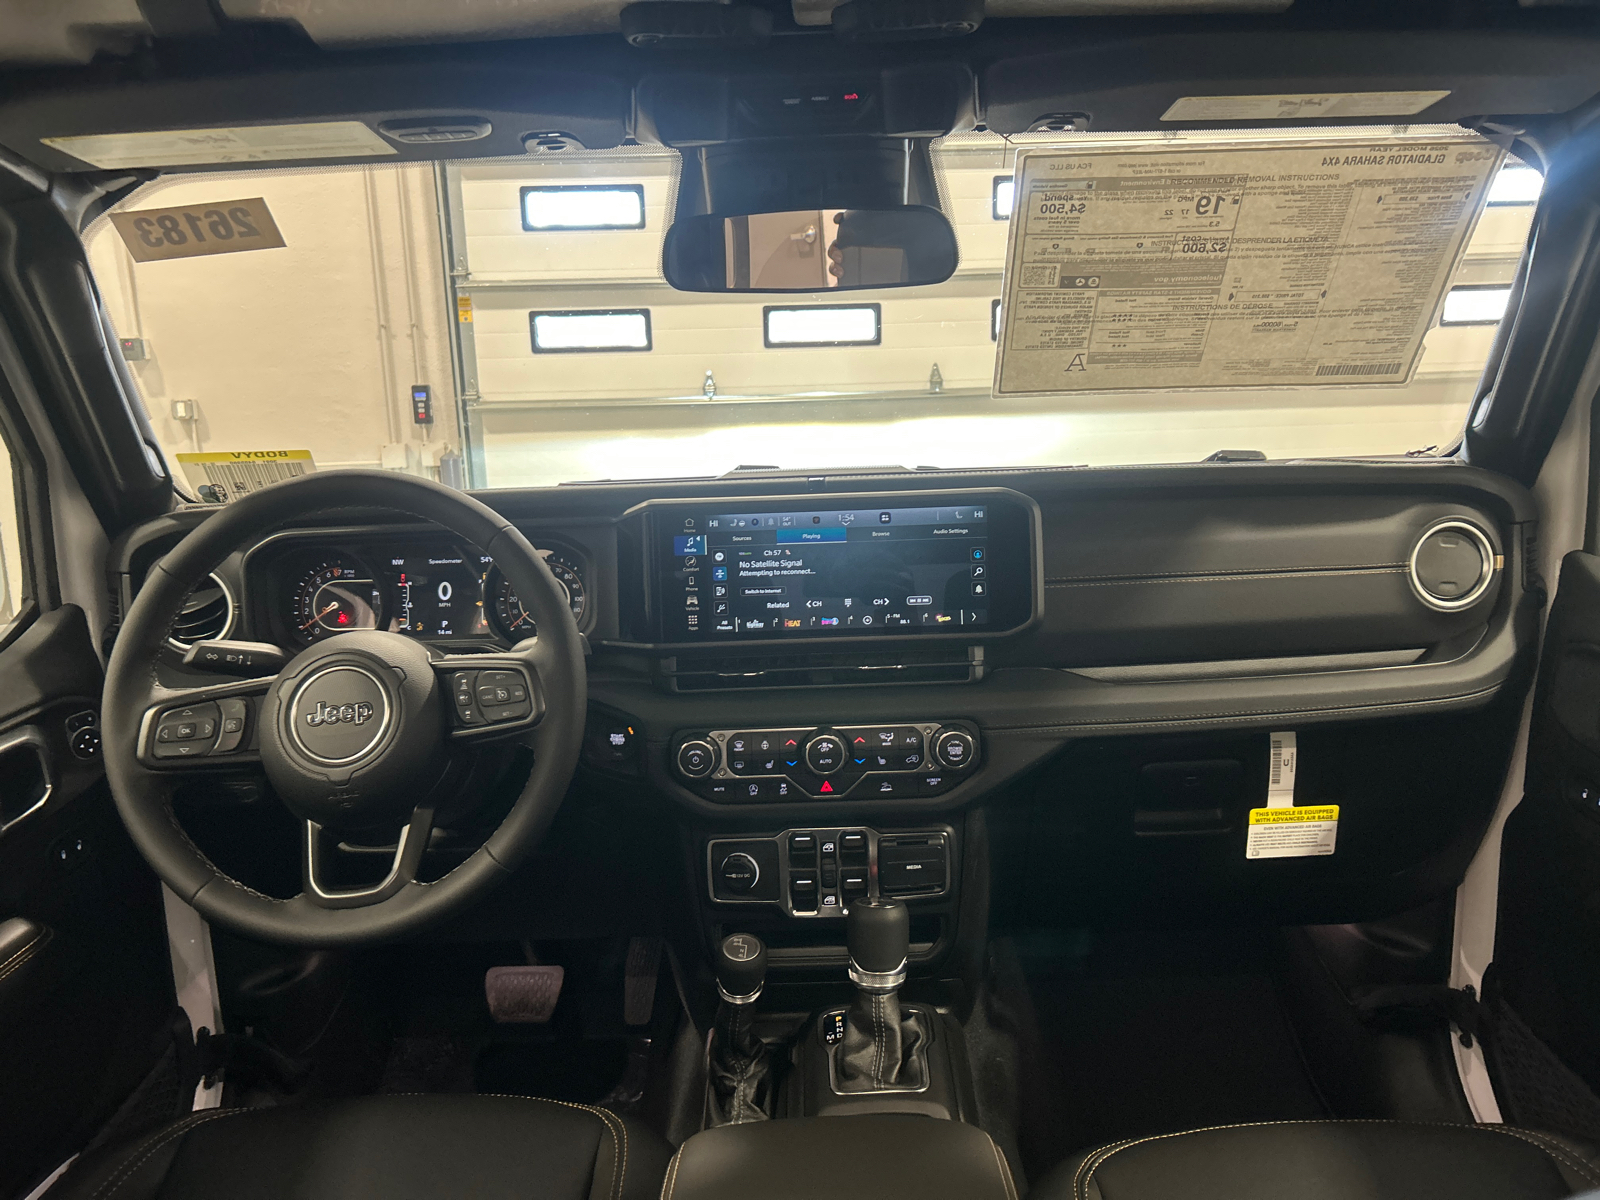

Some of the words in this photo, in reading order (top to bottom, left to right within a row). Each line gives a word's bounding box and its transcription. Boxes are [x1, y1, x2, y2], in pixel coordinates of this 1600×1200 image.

[1236, 175, 1276, 183] REMOVAL
[751, 560, 779, 568] Satellite
[780, 559, 803, 568] Signal
[438, 582, 452, 600] 0
[306, 701, 374, 727] Jeep
